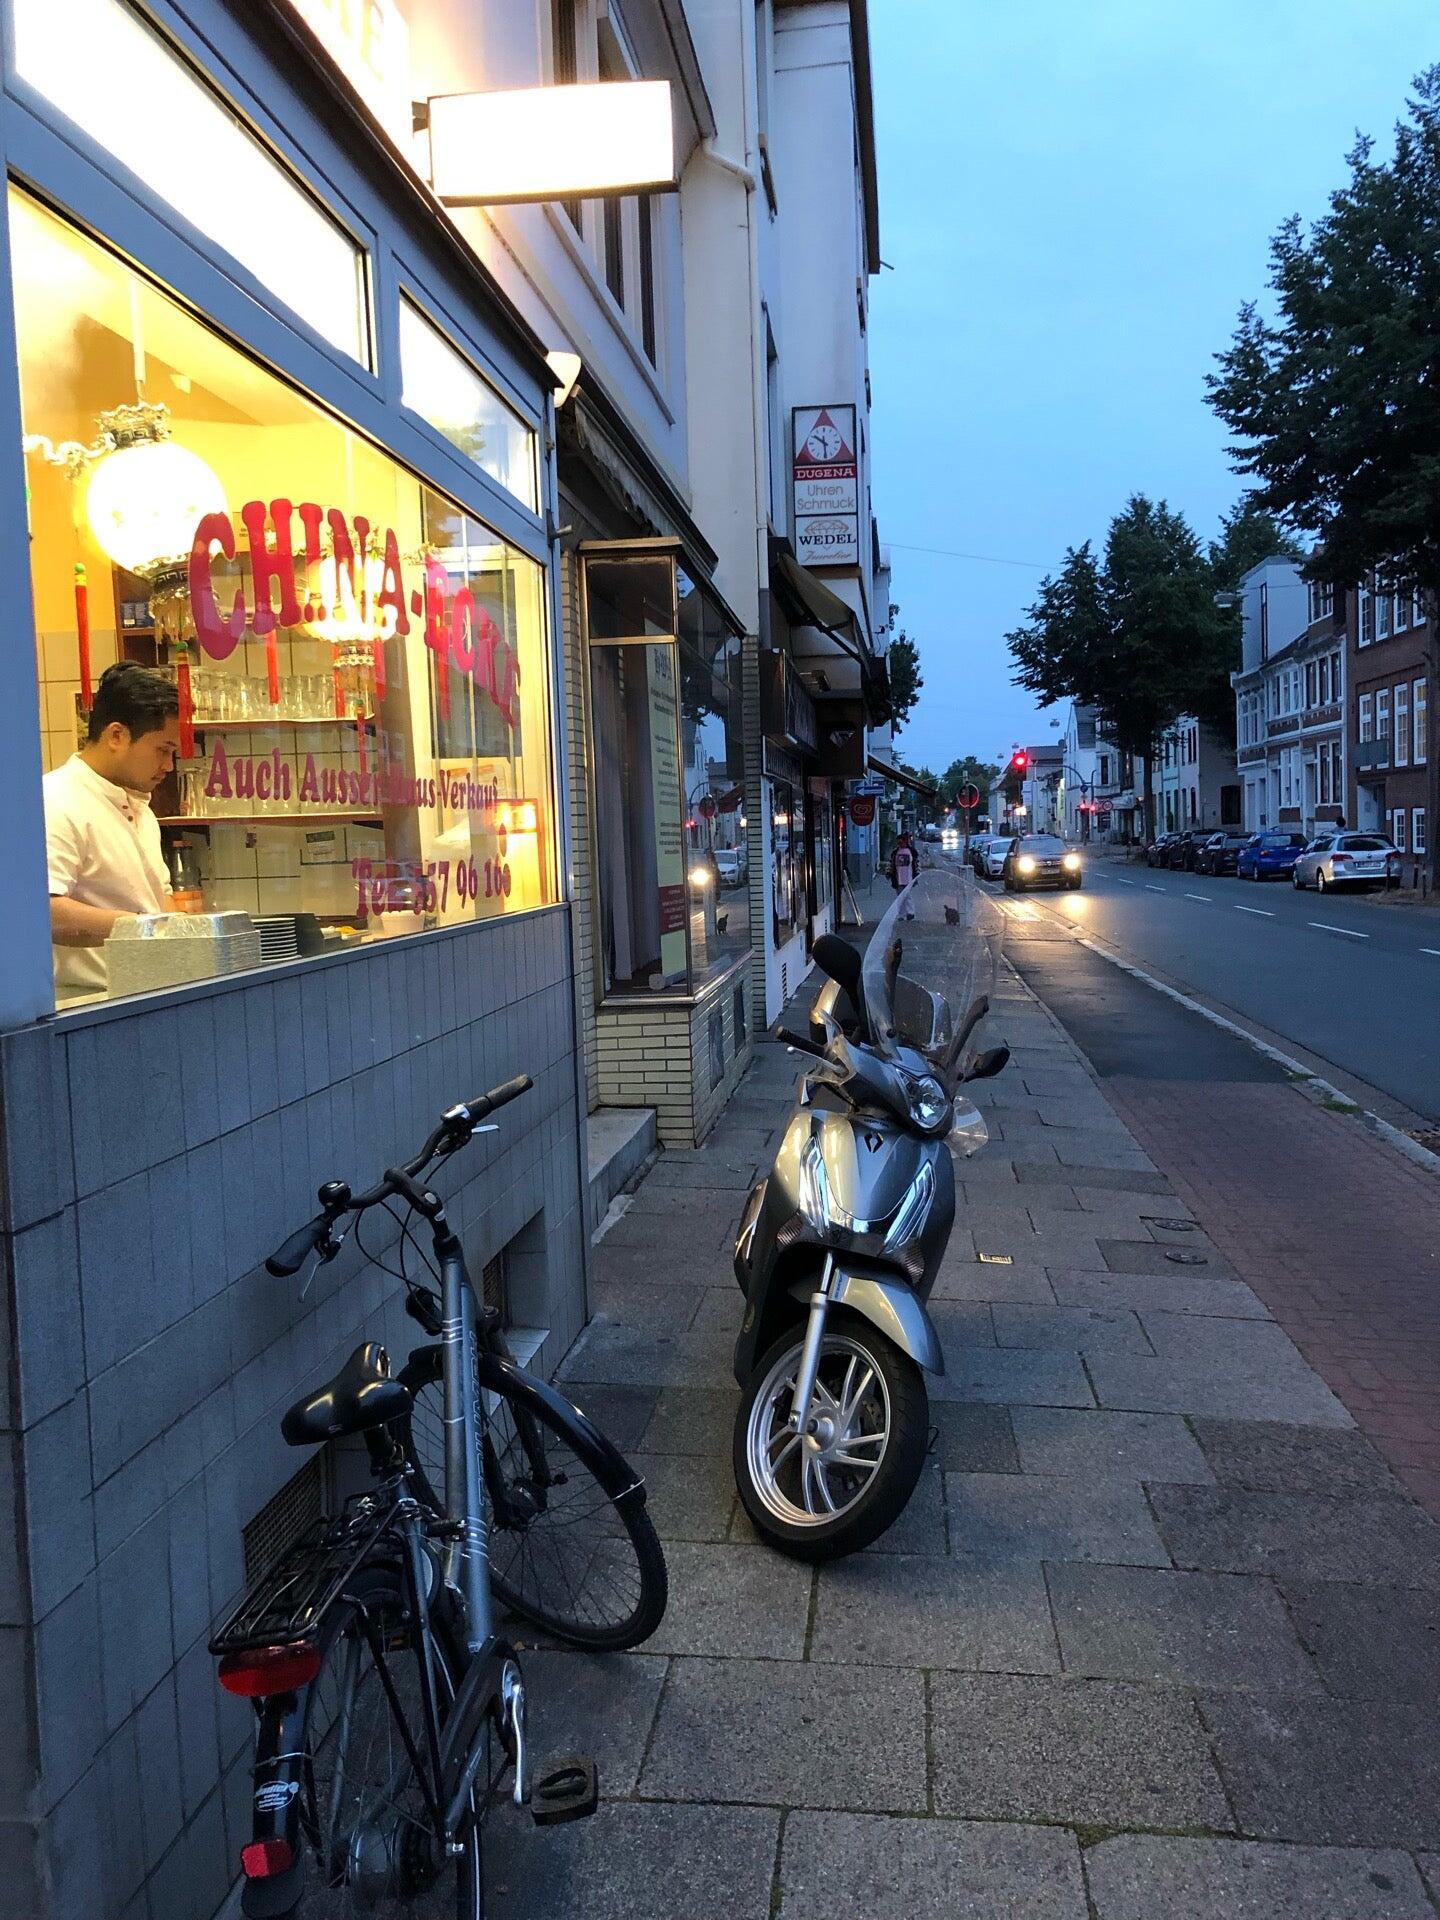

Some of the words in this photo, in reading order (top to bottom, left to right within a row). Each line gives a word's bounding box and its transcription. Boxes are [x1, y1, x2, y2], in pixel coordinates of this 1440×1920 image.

[796, 467, 854, 479] DUGENA
[807, 484, 844, 497] Uhren
[796, 496, 855, 511] Schmuck
[798, 533, 857, 546] WEDEL
[204, 738, 291, 801] Auch
[456, 854, 478, 909] 96
